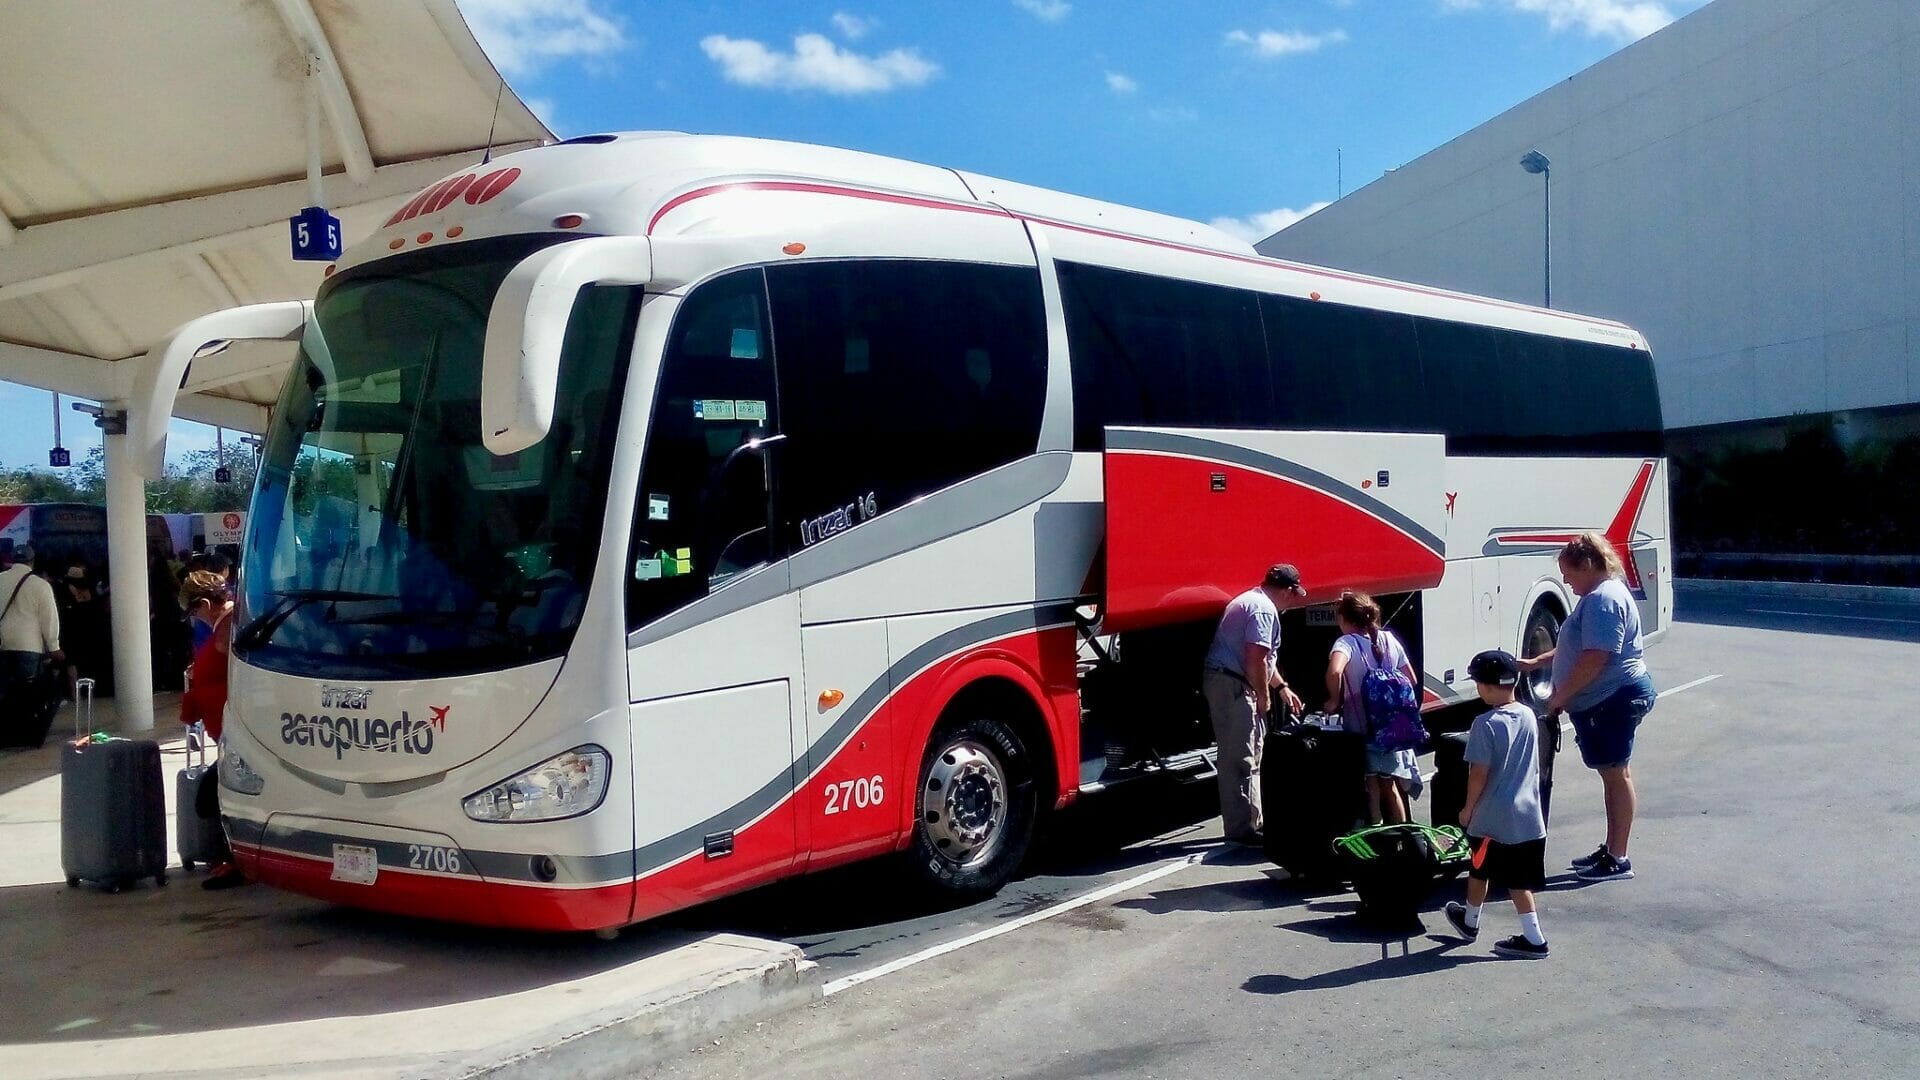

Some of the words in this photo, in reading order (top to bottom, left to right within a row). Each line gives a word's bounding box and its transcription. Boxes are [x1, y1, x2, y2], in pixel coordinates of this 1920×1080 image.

[298, 222, 310, 248] 5
[327, 224, 338, 250] 5
[53, 453, 67, 463] 19
[218, 472, 229, 480] 21
[281, 710, 434, 761] aeropuerto
[824, 774, 884, 815] 2706
[408, 844, 461, 874] 2706
